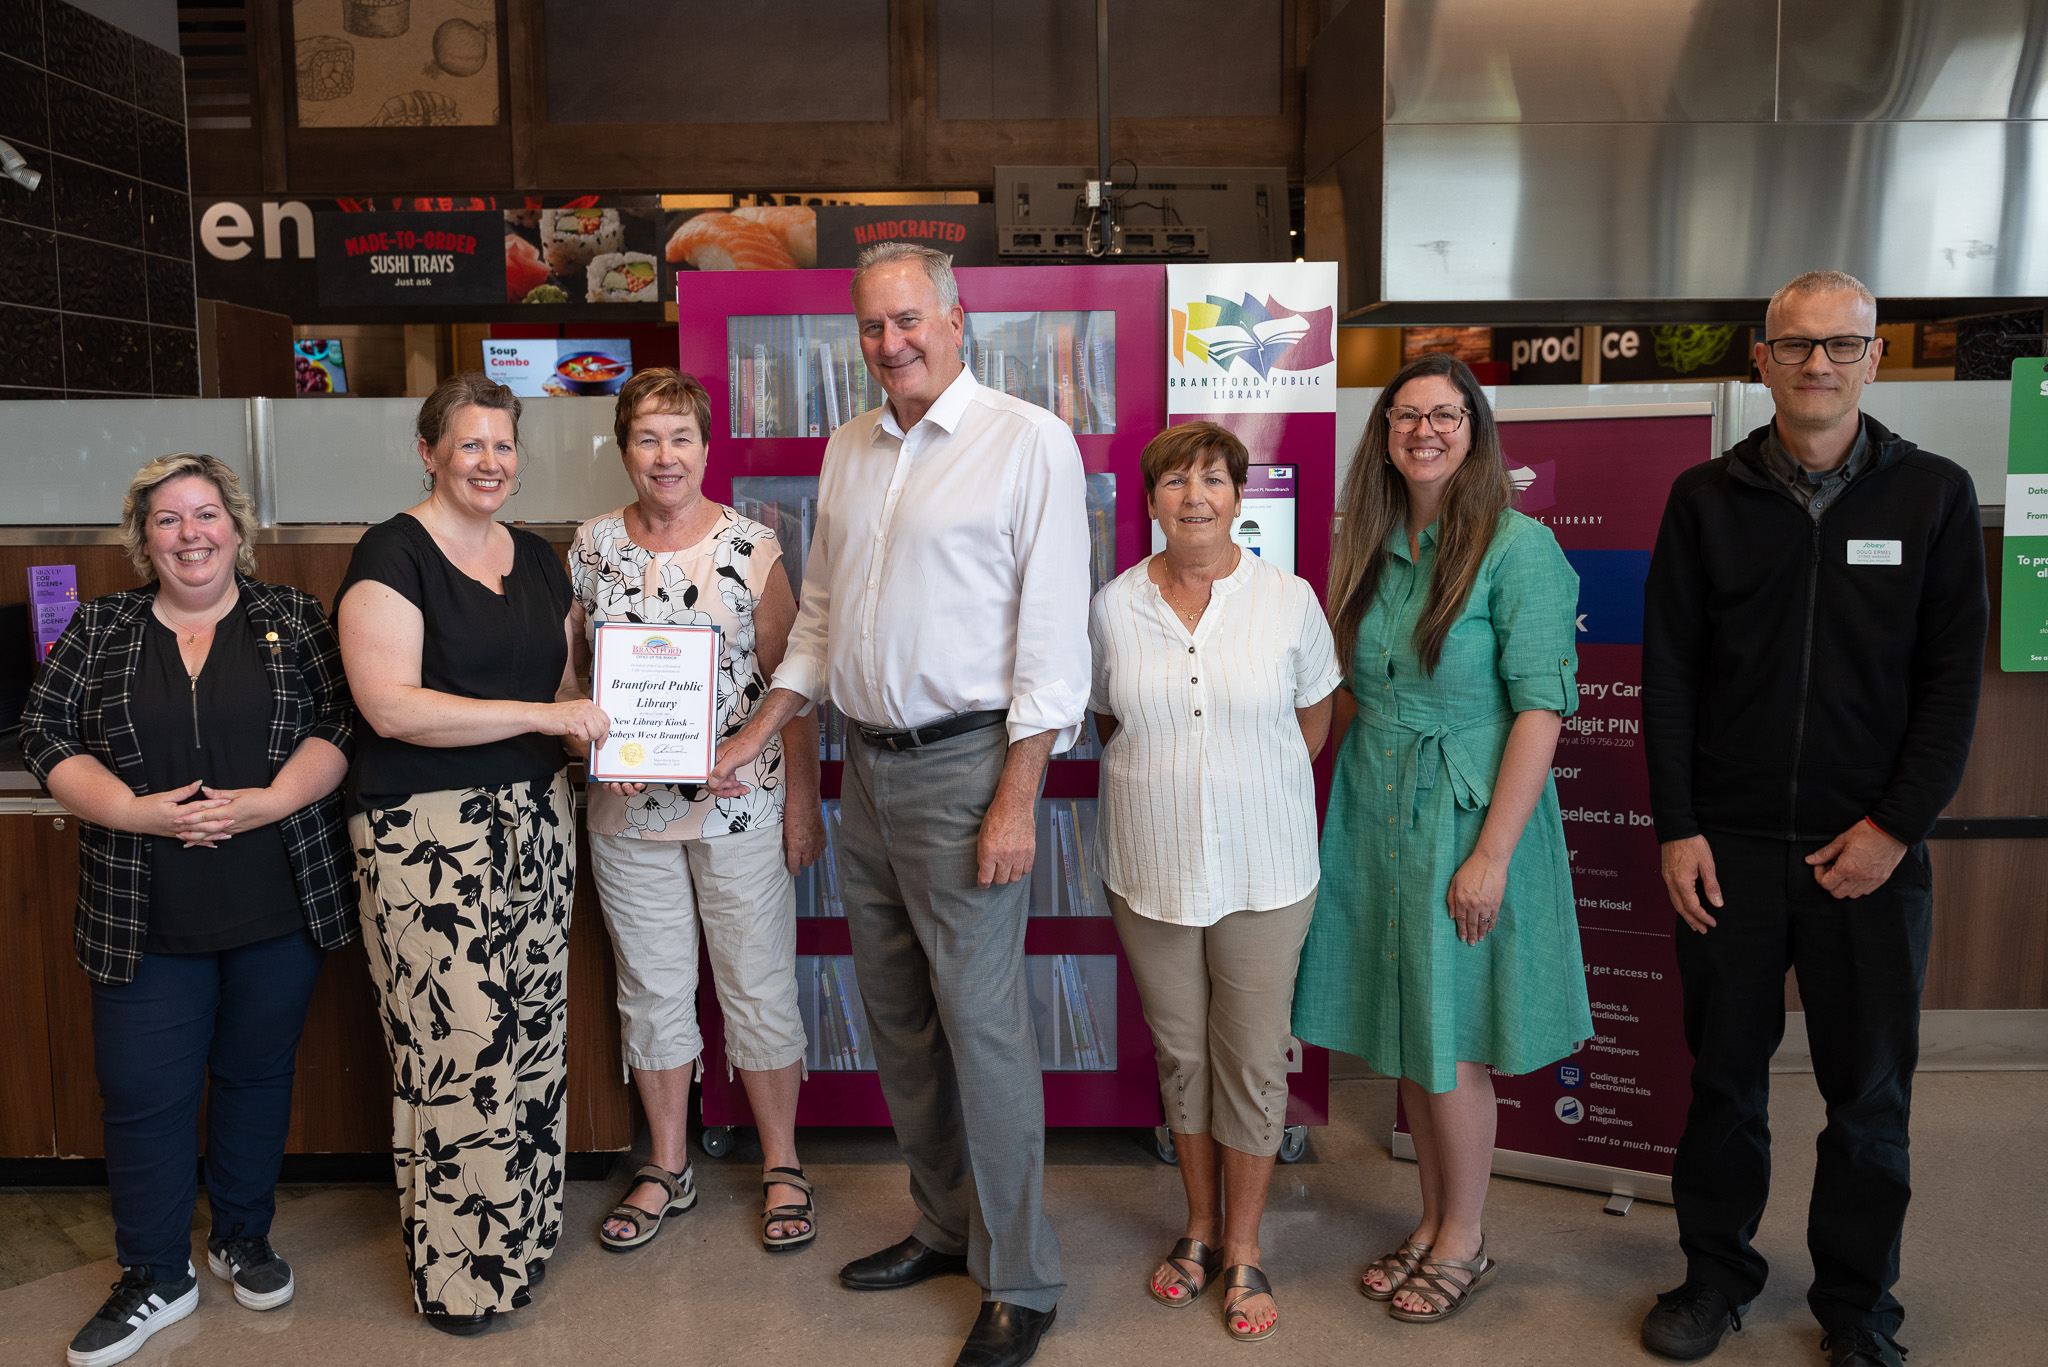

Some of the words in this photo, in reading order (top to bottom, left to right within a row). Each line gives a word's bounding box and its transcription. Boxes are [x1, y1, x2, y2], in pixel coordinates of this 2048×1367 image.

[854, 220, 966, 244] HANDCRAFTED
[344, 230, 477, 256] MADE-TO-ORDER
[370, 255, 410, 274] SUSHI
[412, 254, 454, 274] TRAYS
[394, 278, 414, 286] Just
[416, 277, 432, 286] ask
[490, 346, 518, 357] Soup
[1512, 328, 1640, 371] prodce
[491, 358, 530, 367] Combo
[1062, 374, 1069, 387] 5
[1170, 376, 1260, 388] BRANTFORD
[1272, 375, 1320, 386] PUBLIC
[1213, 388, 1271, 400] LIBRARY
[2028, 486, 2048, 495] Date
[1553, 516, 1602, 524] LIBRARY
[2026, 512, 2048, 520] From
[2017, 555, 2030, 565] To
[2033, 557, 2048, 567] pro
[2037, 568, 2048, 578] al
[632, 645, 682, 655] BRANTFORD
[612, 679, 665, 692] Brantford
[668, 680, 704, 692] Public
[1612, 682, 1642, 697] Car
[636, 697, 678, 711] Library
[612, 717, 631, 725] New
[632, 717, 664, 727] Library
[665, 718, 688, 727] Kiosk
[1561, 716, 1604, 736] -digit
[1608, 718, 1639, 734] PIN
[608, 730, 635, 739] Sobeys
[638, 731, 657, 739] West
[659, 731, 700, 741] Brantford
[1558, 737, 1570, 745] ary
[1581, 738, 1634, 747] 519-756-2220
[1552, 766, 1582, 779] oor
[1560, 806, 1610, 824] select
[1614, 812, 1624, 824] a
[1629, 810, 1654, 827] bo
[1576, 866, 1587, 874] for
[1588, 868, 1618, 878] receipts
[1579, 897, 1598, 908] the
[1600, 899, 1632, 911] Kiosk!
[1593, 966, 1610, 976] get
[1613, 968, 1648, 979] access
[1651, 971, 1663, 980] to
[1590, 1002, 1621, 1011] eBooks
[1591, 1010, 1639, 1023] Audiobooks
[1590, 1035, 1616, 1044] Digital
[1590, 1044, 1640, 1056] newspapers
[1590, 1072, 1618, 1084] Coding
[1590, 1082, 1634, 1094] electronics
[1635, 1088, 1651, 1096] kits
[1496, 1098, 1521, 1108] aming
[1590, 1105, 1616, 1115] Digital
[1589, 1115, 1633, 1127] magazines
[1608, 1138, 1621, 1146] so
[1622, 1140, 1651, 1151] much
